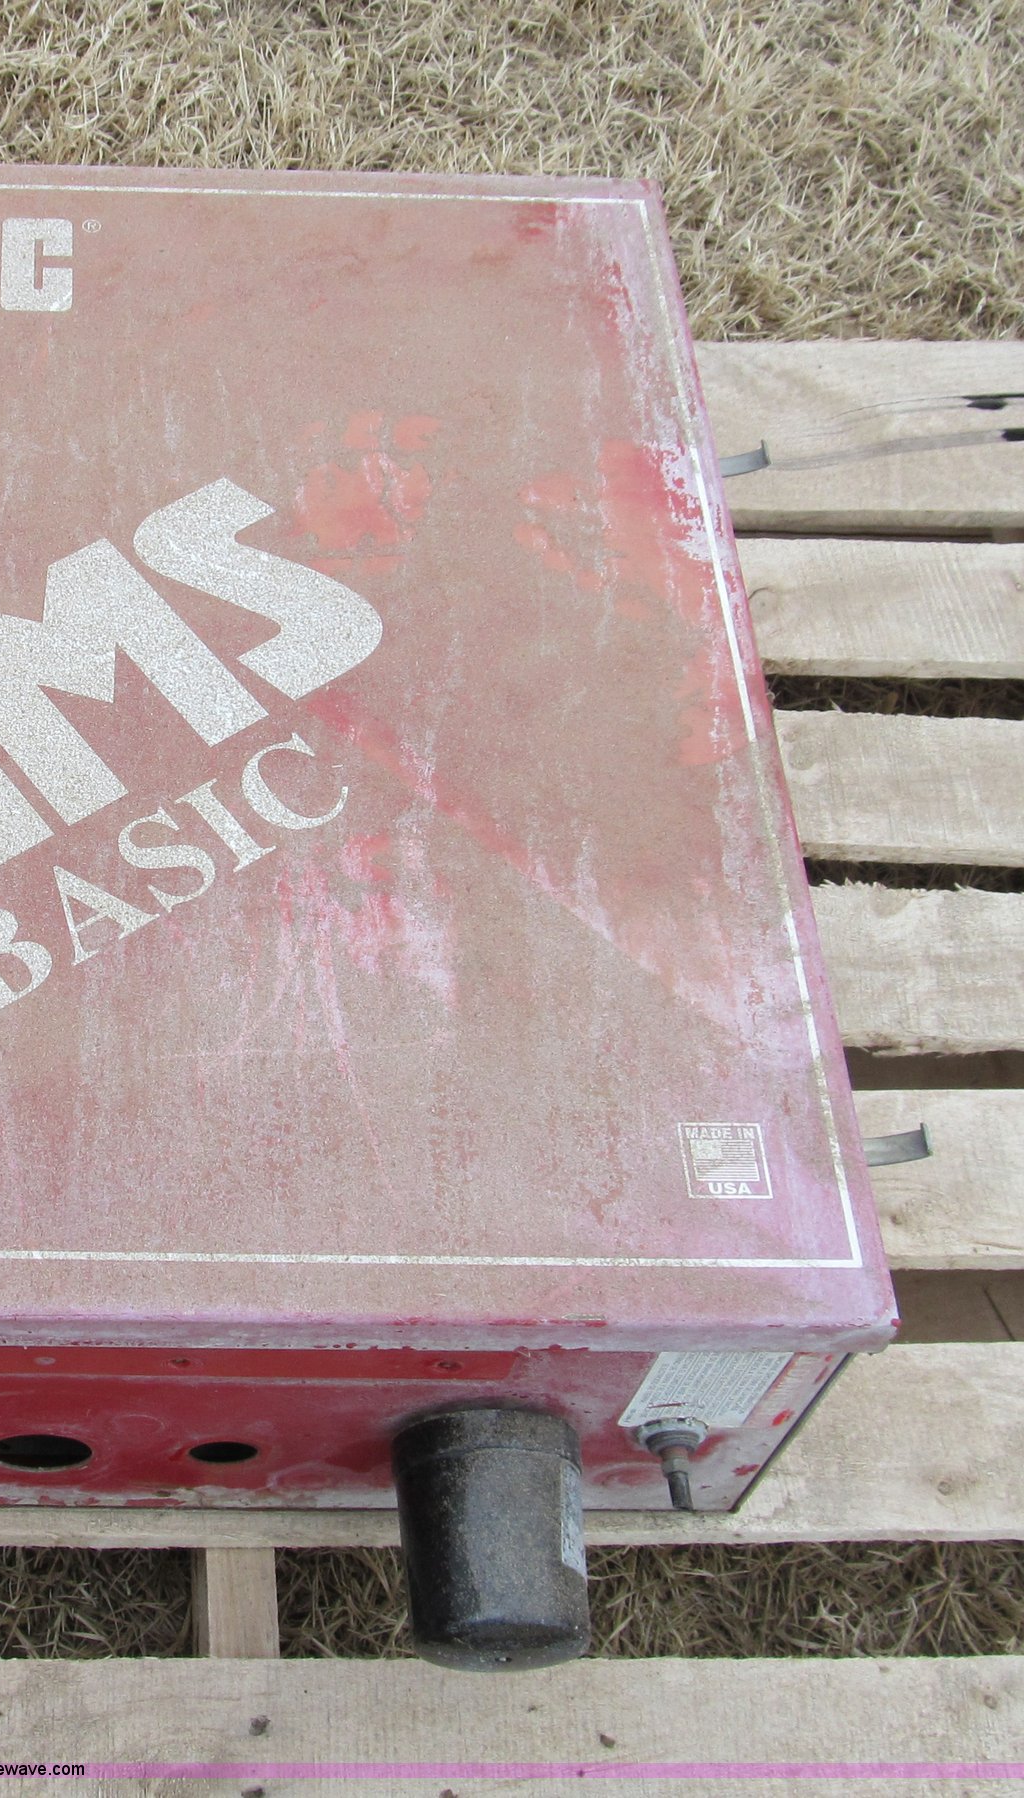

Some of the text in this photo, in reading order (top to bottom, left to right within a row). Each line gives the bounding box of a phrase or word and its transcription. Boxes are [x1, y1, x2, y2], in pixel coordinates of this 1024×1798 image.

[684, 1127, 755, 1139] MADE IN
[708, 1182, 753, 1194] USA
